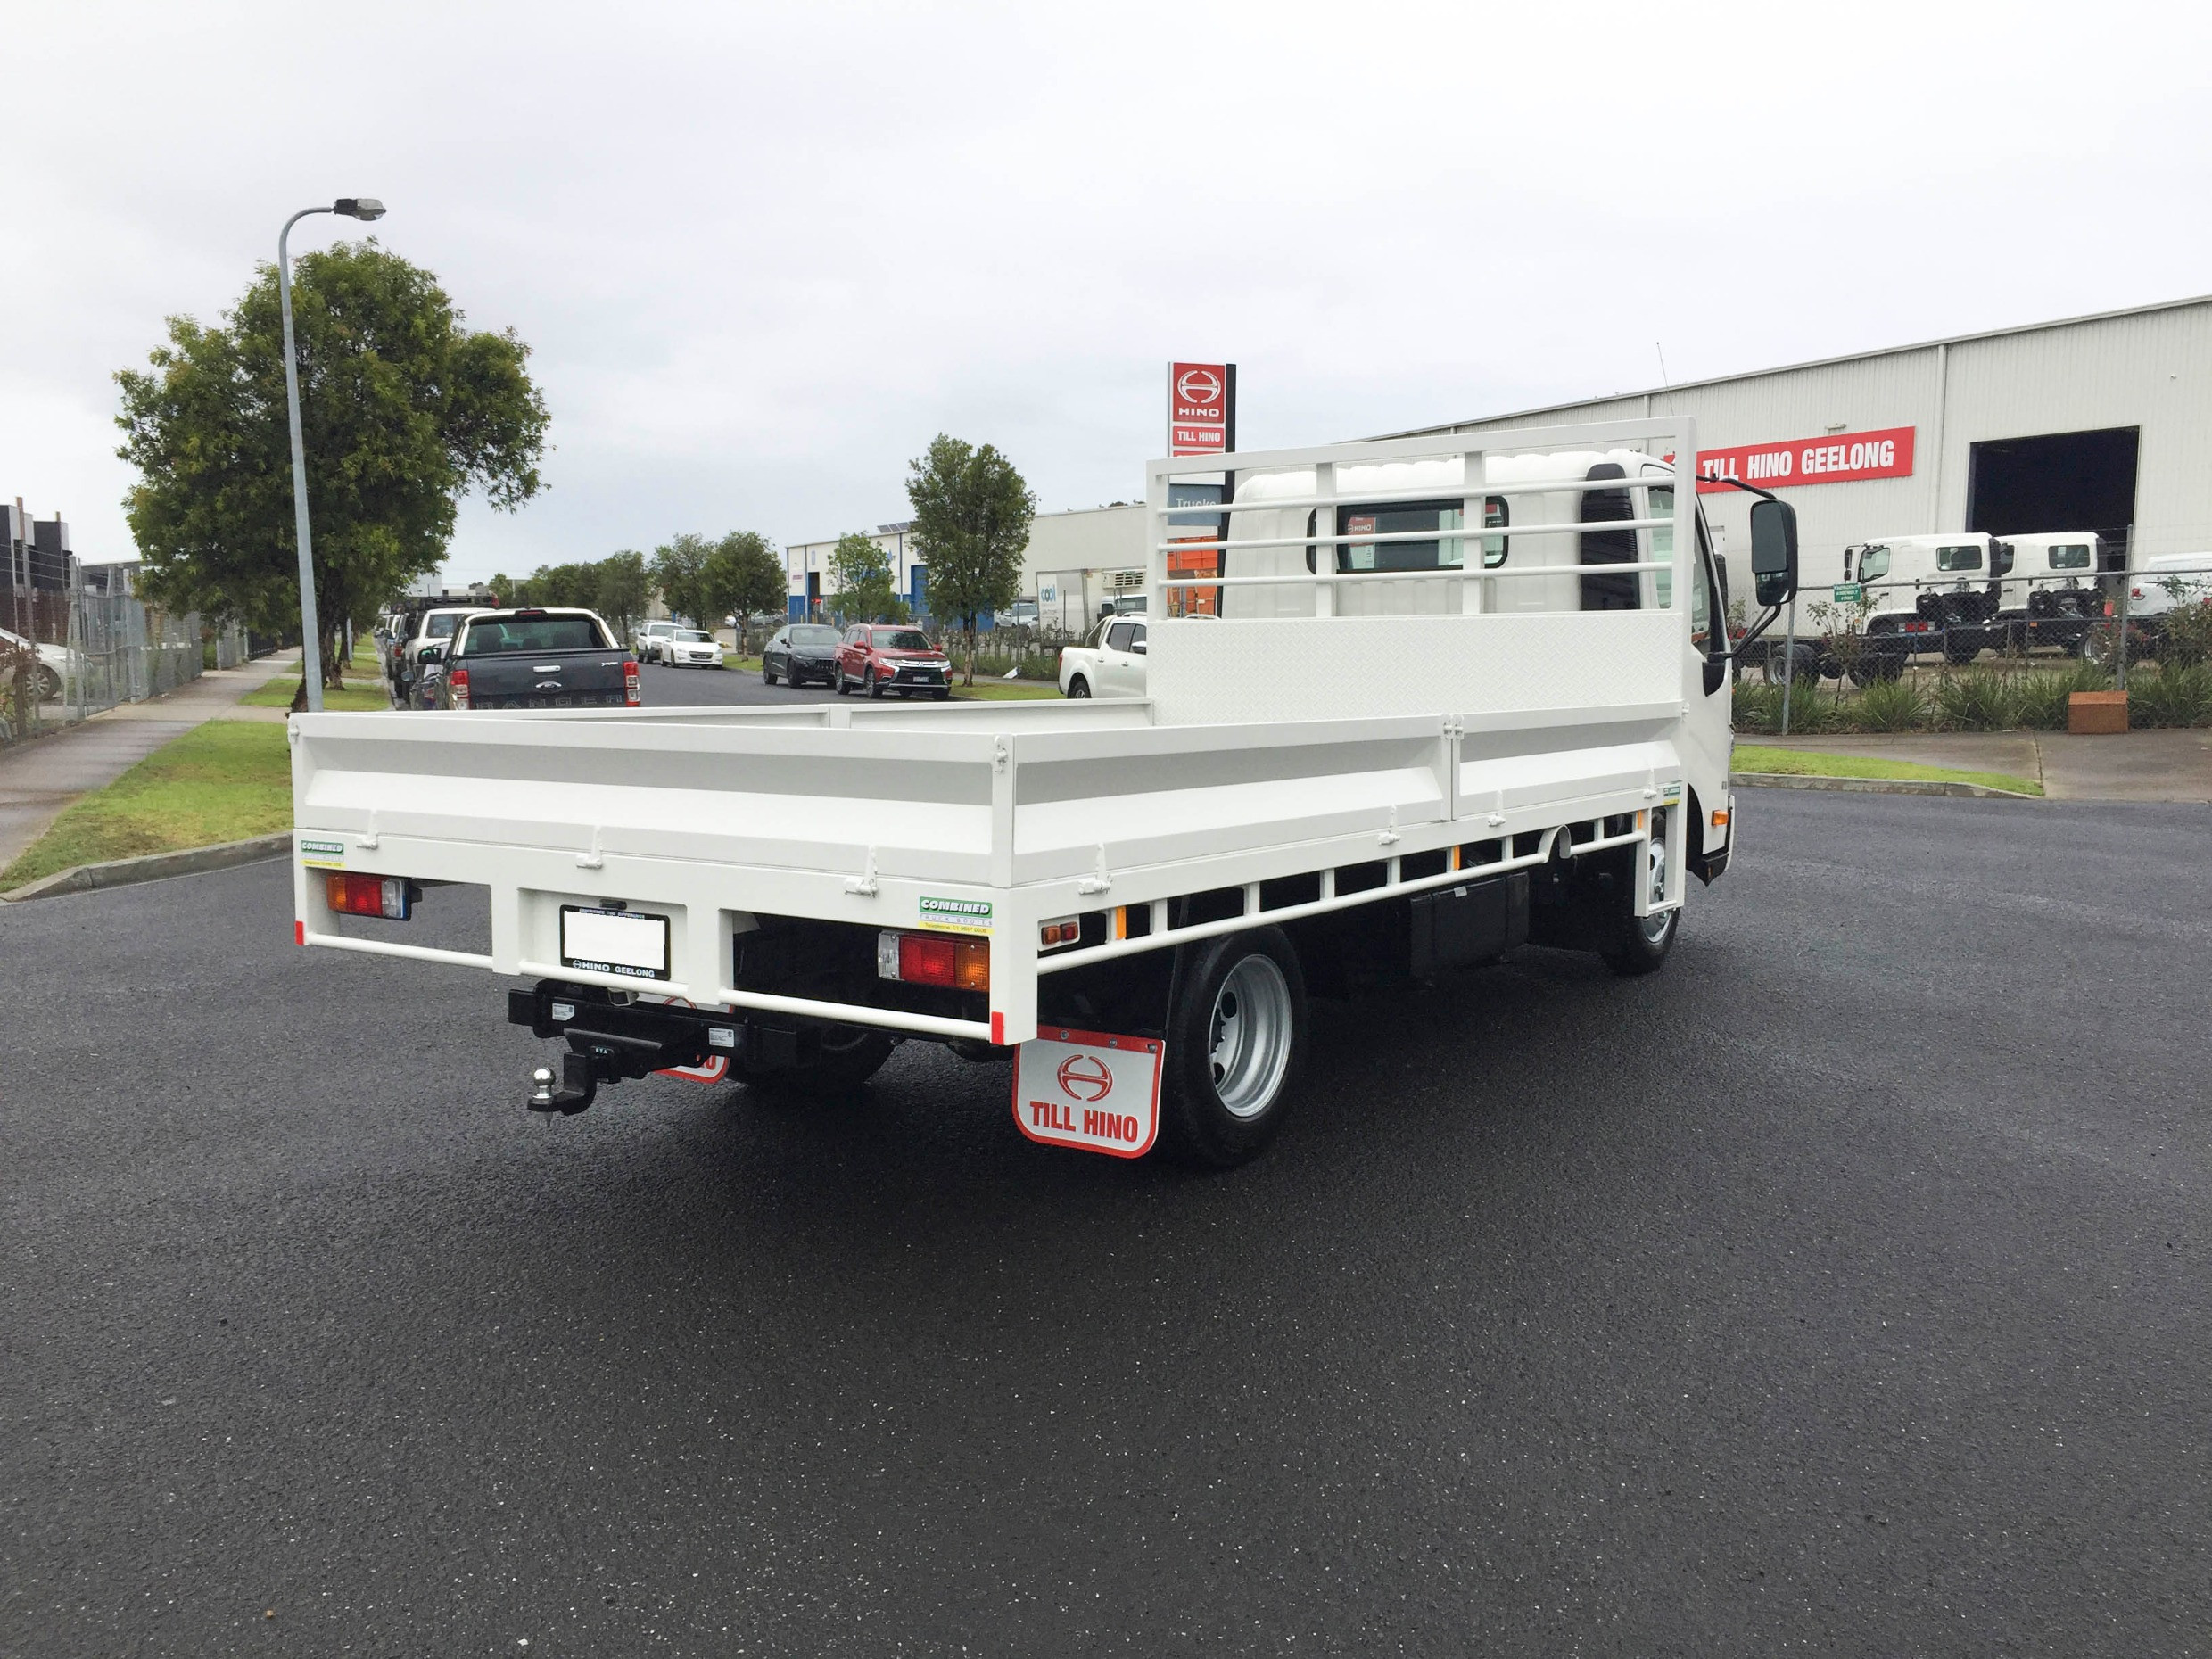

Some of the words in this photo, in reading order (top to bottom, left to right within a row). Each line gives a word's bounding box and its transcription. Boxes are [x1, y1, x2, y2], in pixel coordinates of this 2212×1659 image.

[1178, 408, 1220, 417] HINO
[1177, 431, 1196, 442] TILL
[1199, 432, 1221, 442] HINO
[1703, 457, 1739, 483] TILL
[1747, 451, 1793, 479] HINO
[1801, 440, 1894, 475] GEELONG
[301, 842, 343, 853] COMBINED
[920, 899, 990, 914] COMBINED
[582, 962, 610, 972] HINO
[615, 966, 655, 978] GEELONG
[1029, 1101, 1077, 1132] TILL
[1083, 1109, 1139, 1143] HINO
